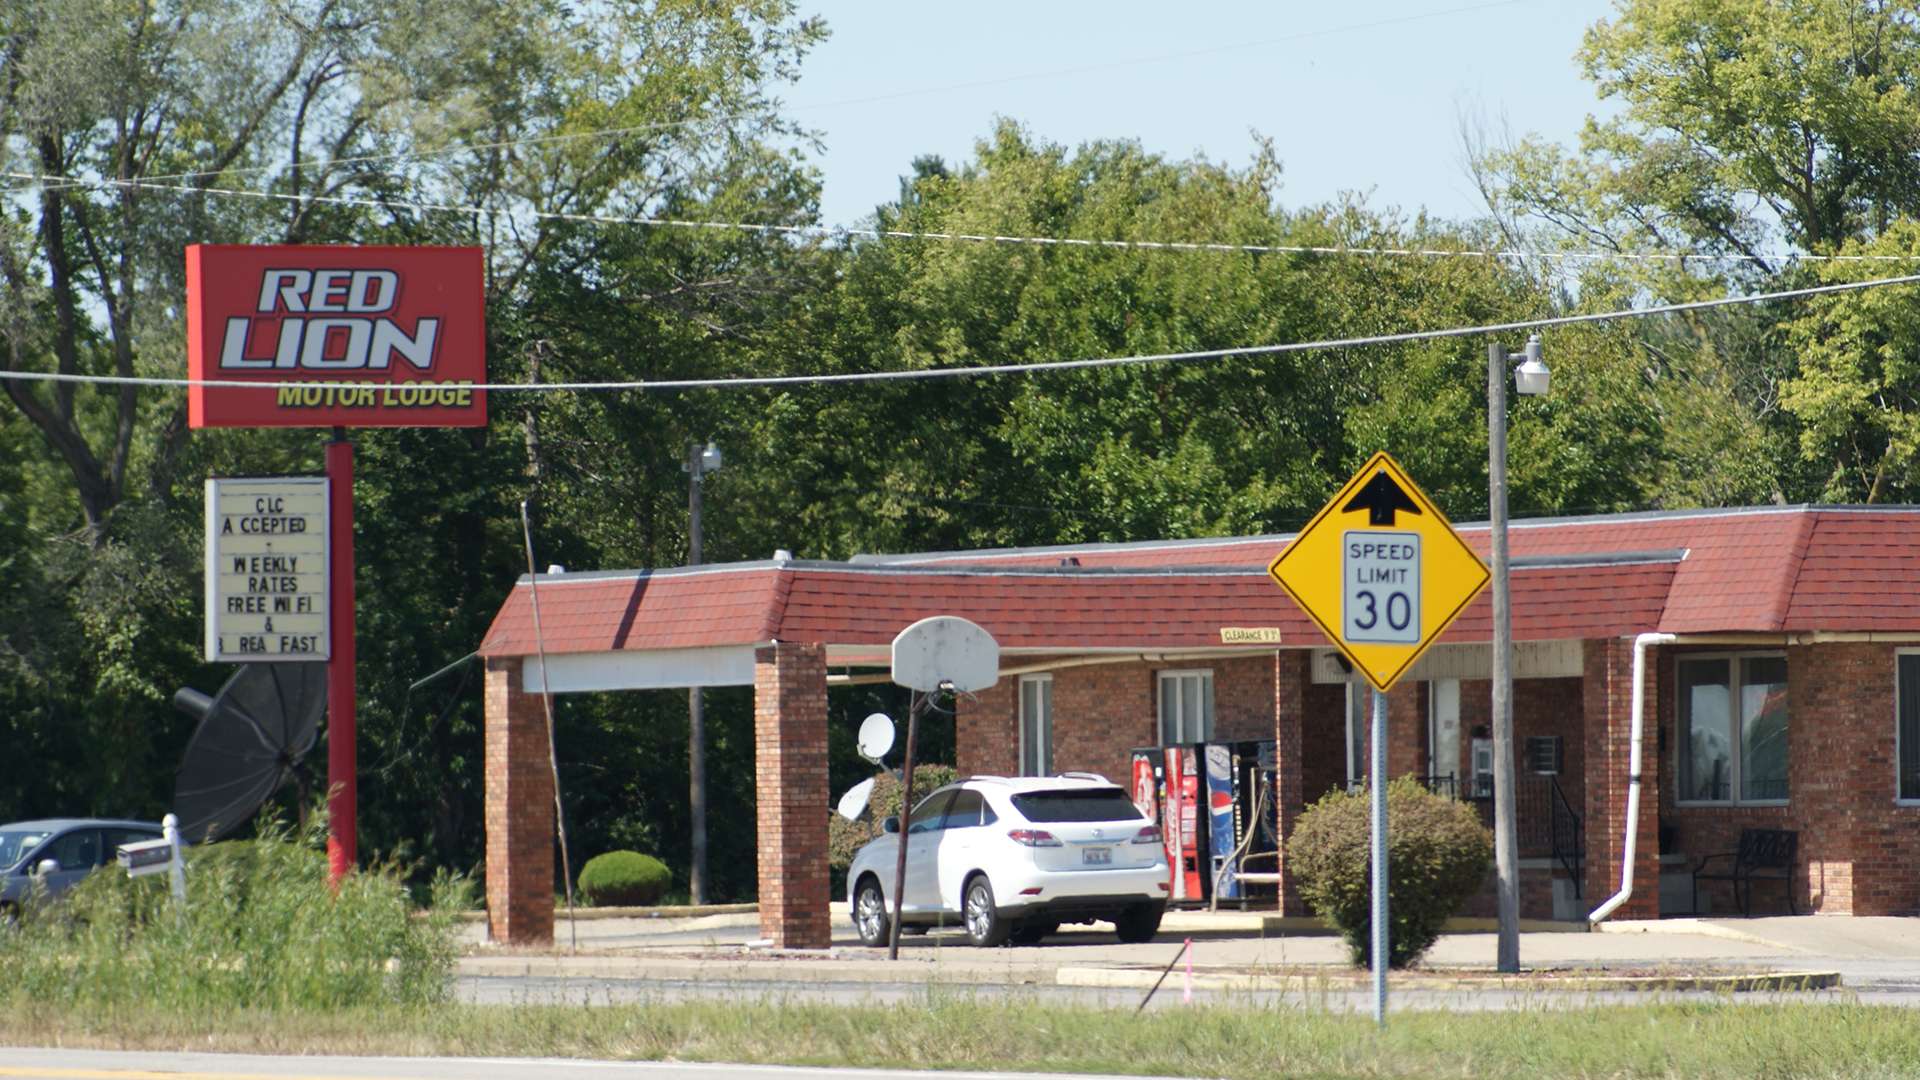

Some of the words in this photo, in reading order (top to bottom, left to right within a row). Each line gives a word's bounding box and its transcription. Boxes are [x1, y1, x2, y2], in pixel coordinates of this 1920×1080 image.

[257, 268, 398, 313] RED
[219, 317, 440, 369] LION
[277, 380, 375, 407] MOTOR
[382, 380, 473, 407] LODGE
[1350, 543, 1415, 560] SPEED
[233, 556, 297, 573] WEEKLY
[1357, 567, 1408, 584] LIMIT
[248, 576, 298, 593] RATES
[227, 596, 267, 613] FREE
[1354, 590, 1411, 631] 30
[264, 616, 274, 633] &
[280, 635, 318, 653] FAST
